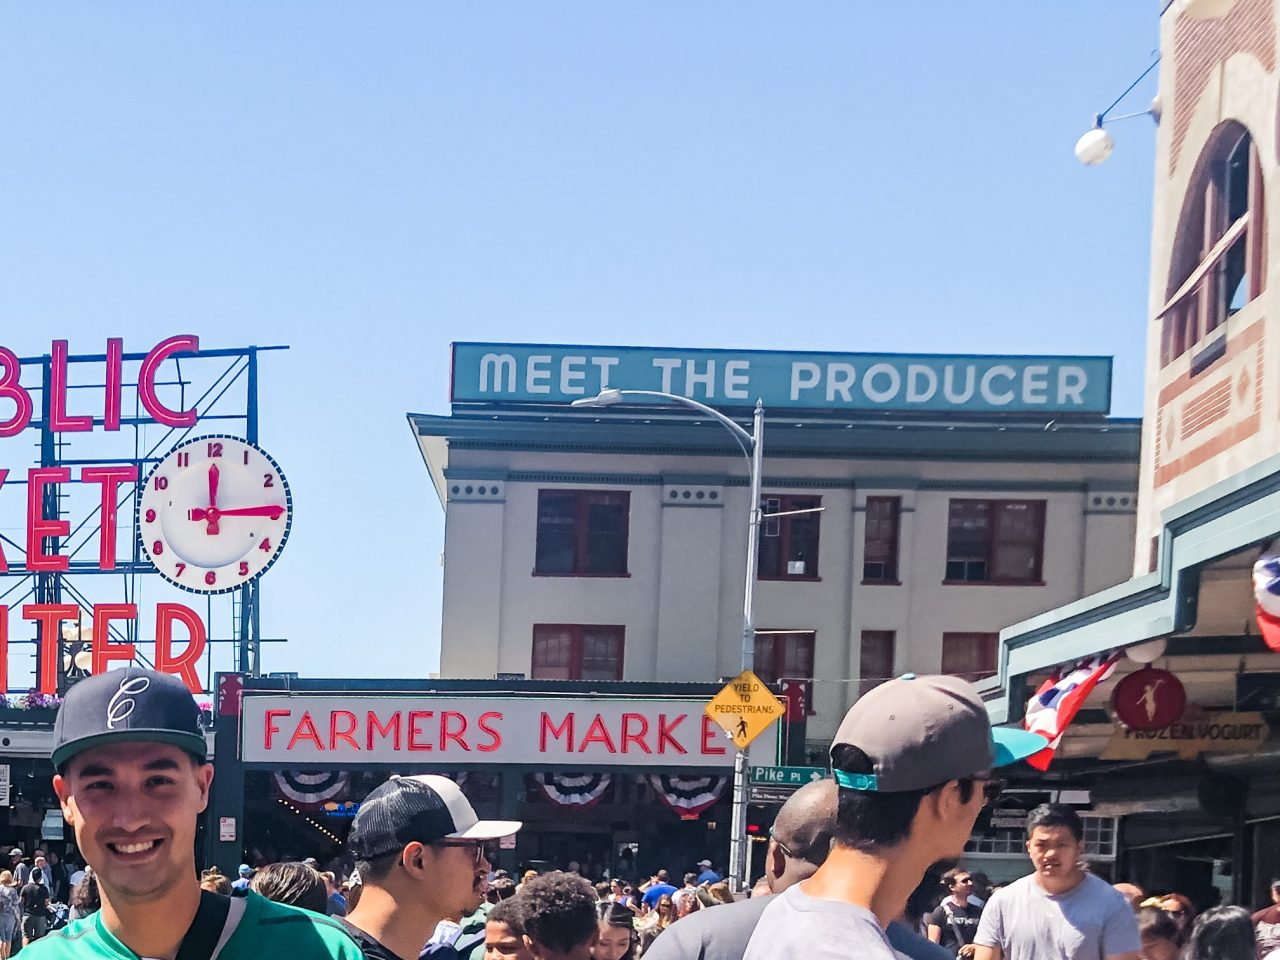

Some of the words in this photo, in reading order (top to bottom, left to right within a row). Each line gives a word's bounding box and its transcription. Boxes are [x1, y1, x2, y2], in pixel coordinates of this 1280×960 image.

[479, 353, 620, 395] MEET
[653, 358, 750, 399] THE
[790, 361, 1089, 405] PRODUCER
[207, 442, 223, 458] 12
[243, 450, 249, 465] 1
[177, 452, 189, 467] 11
[154, 477, 169, 491] 10
[263, 473, 274, 488] 2
[145, 508, 157, 523] 9
[152, 540, 164, 556] 8
[258, 537, 272, 553] 4
[175, 563, 186, 577] 7
[238, 562, 249, 577] 5
[204, 571, 217, 585] 6
[734, 683, 760, 692] YIELD
[740, 694, 751, 702] TO
[714, 704, 774, 714] PEDESTRIANS
[264, 709, 504, 752] FARMERS
[538, 712, 727, 755] MARKE
[755, 767, 785, 781] Pike
